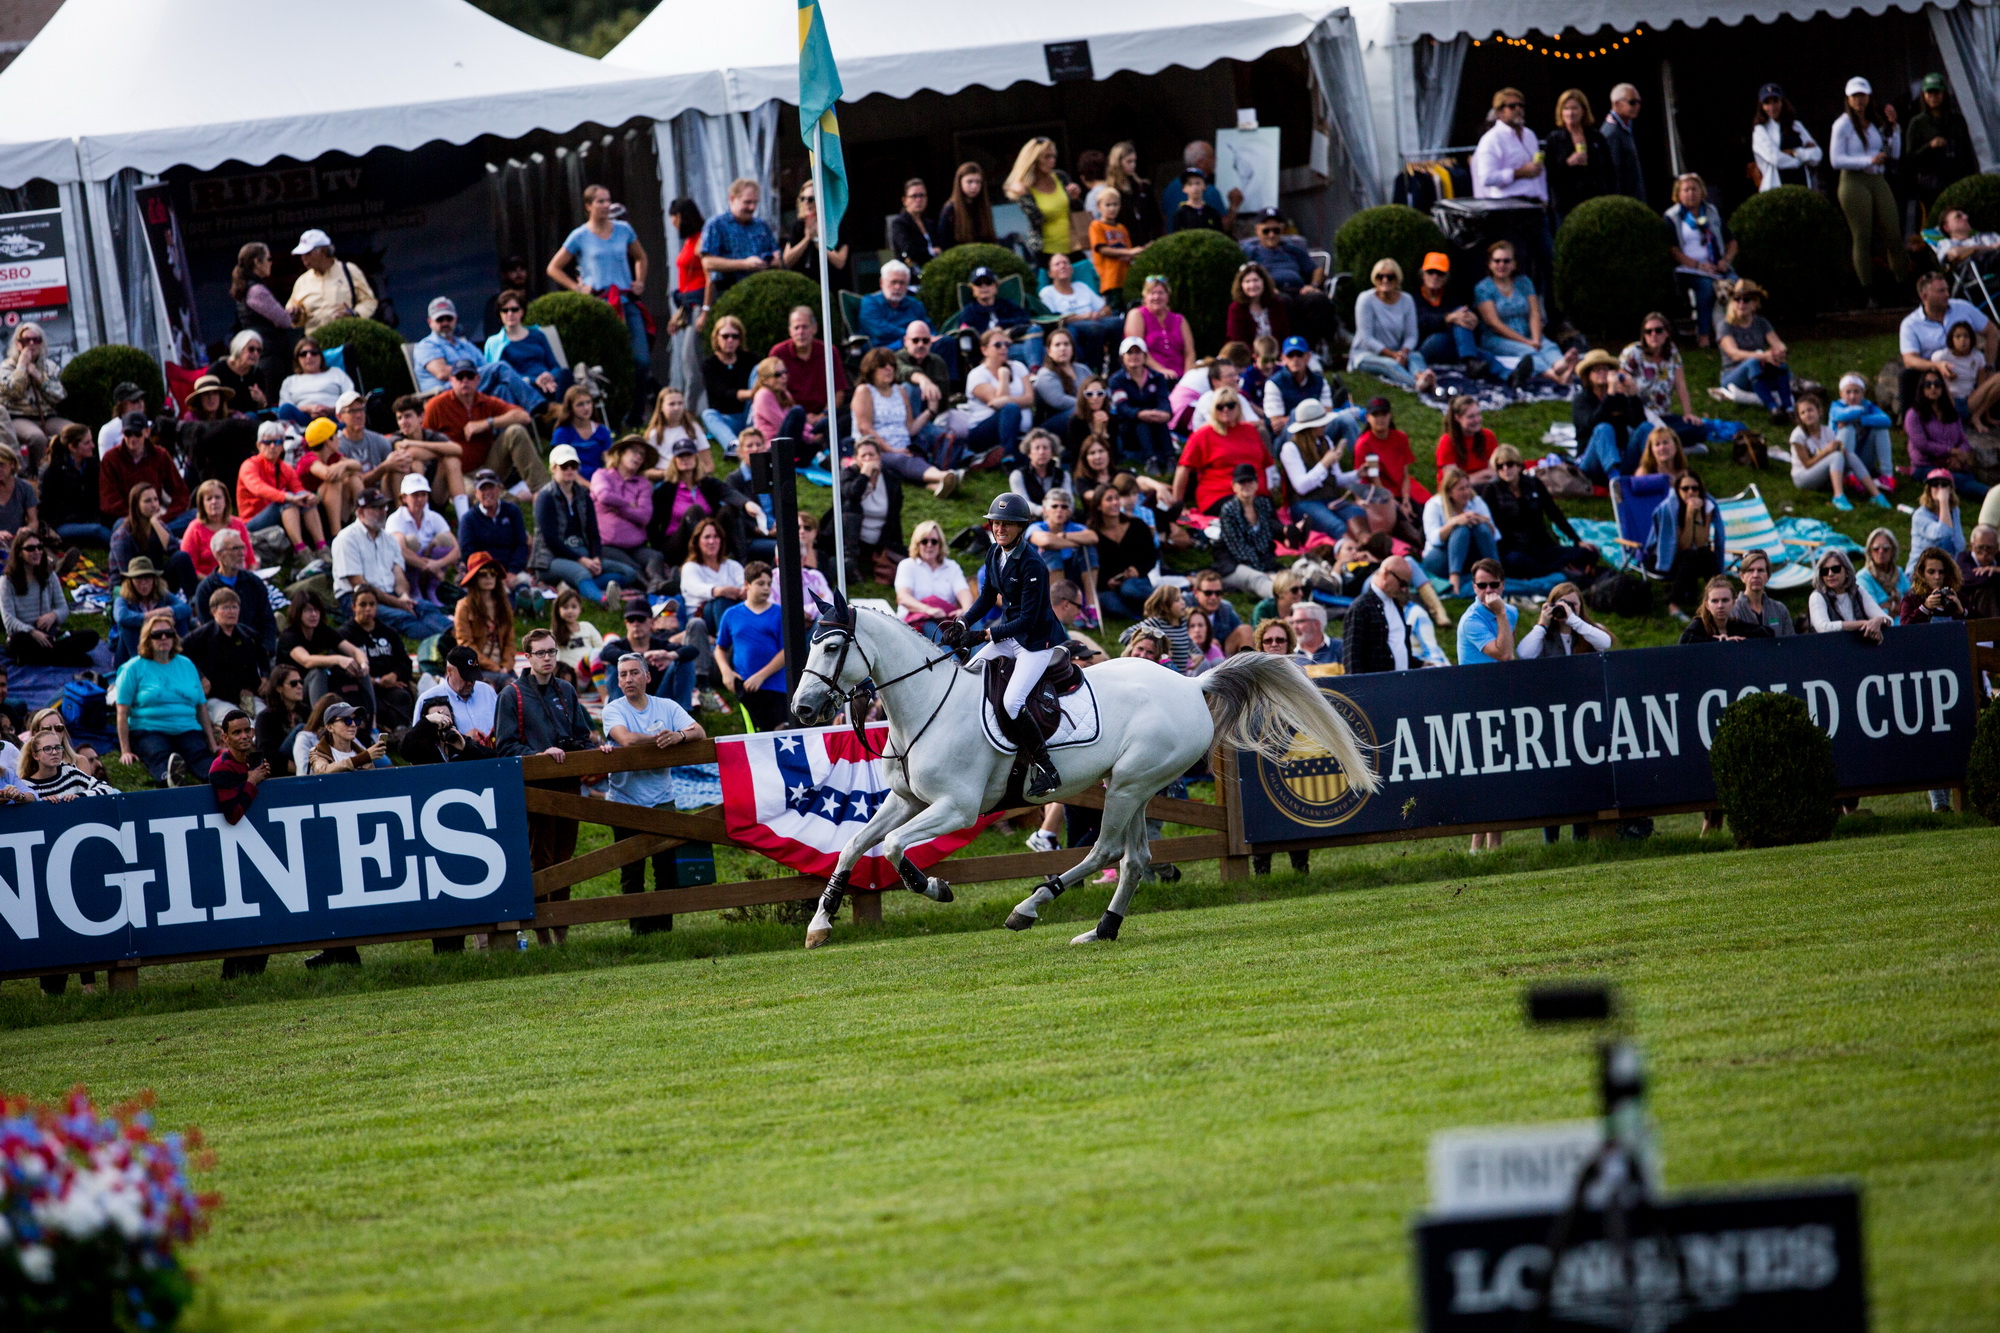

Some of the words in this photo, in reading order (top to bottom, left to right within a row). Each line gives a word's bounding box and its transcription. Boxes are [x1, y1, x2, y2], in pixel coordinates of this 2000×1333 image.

[321, 167, 364, 191] TV
[1388, 692, 1680, 784] AMERICAN
[1697, 679, 1840, 750] GD
[1856, 668, 1960, 739] CUP
[1301, 806, 1322, 816] FARM
[1323, 801, 1348, 815] NORTH
